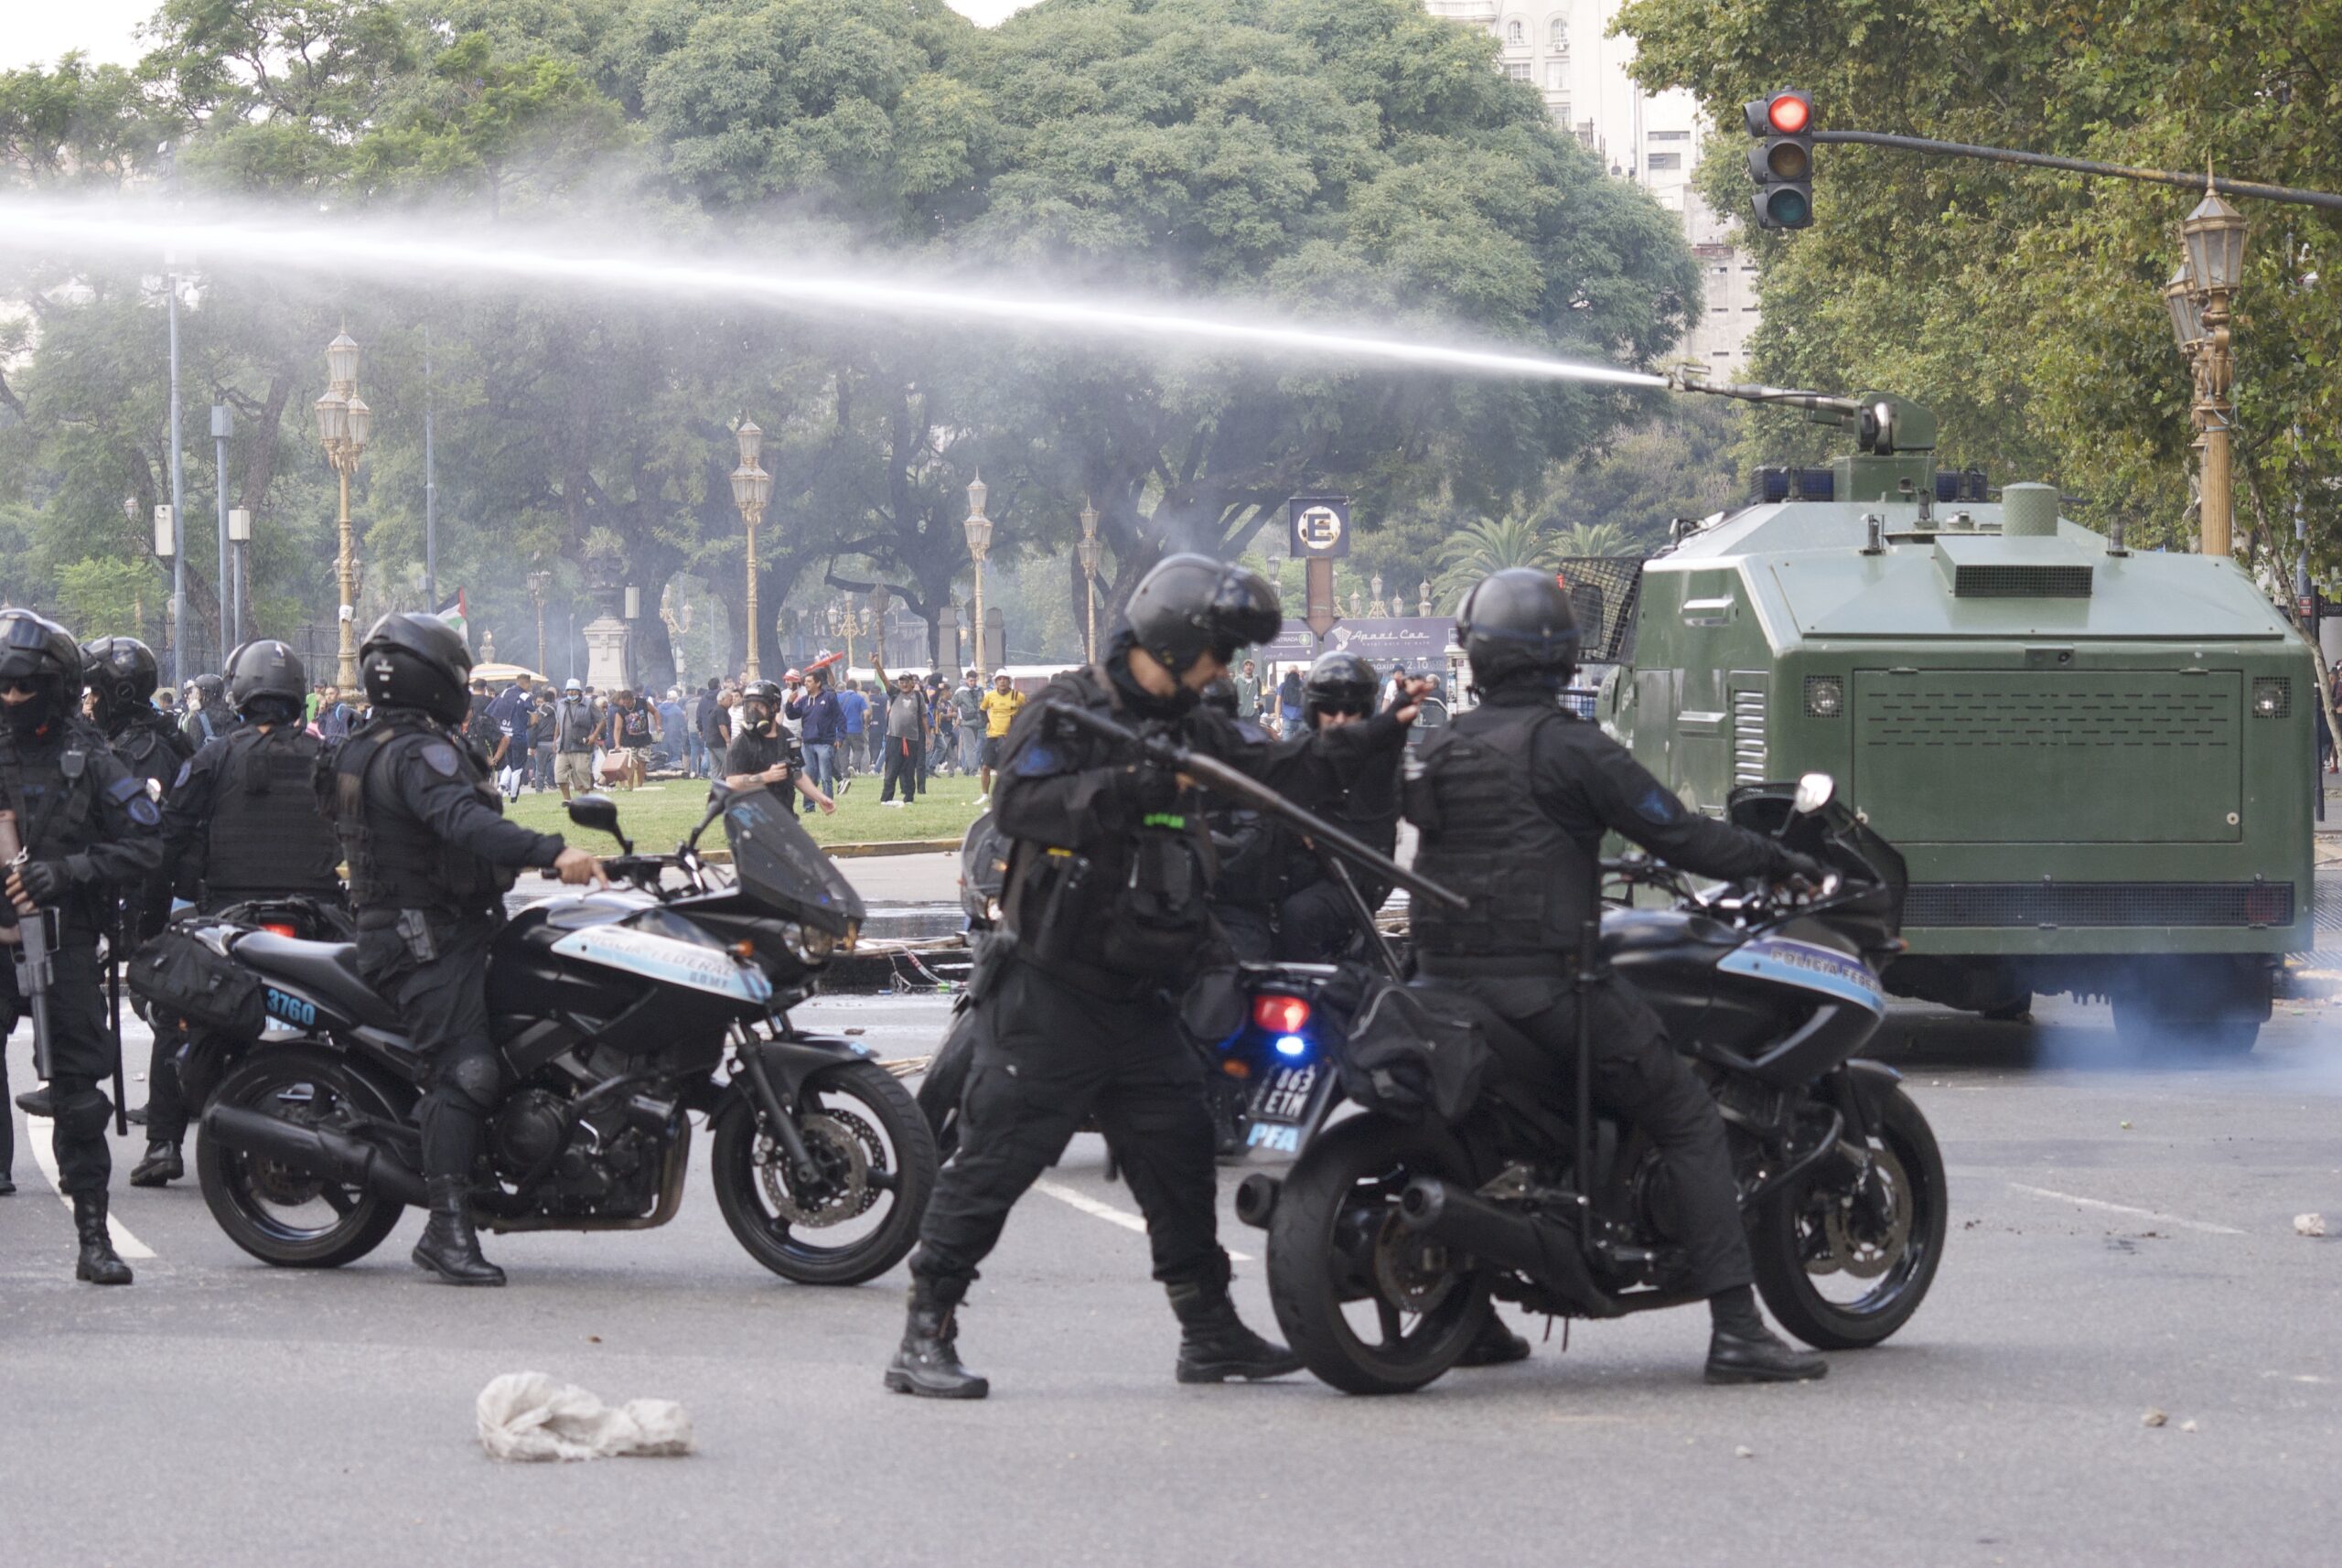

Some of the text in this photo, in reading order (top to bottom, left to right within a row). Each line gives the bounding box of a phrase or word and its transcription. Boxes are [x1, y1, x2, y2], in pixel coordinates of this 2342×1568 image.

[1307, 513, 1332, 542] E
[1350, 629, 1430, 642] Apart Car
[1406, 660, 1429, 671] 2.10
[1771, 946, 1839, 976] POLICIA
[267, 987, 316, 1026] 3760
[1247, 1122, 1299, 1152] PFA
